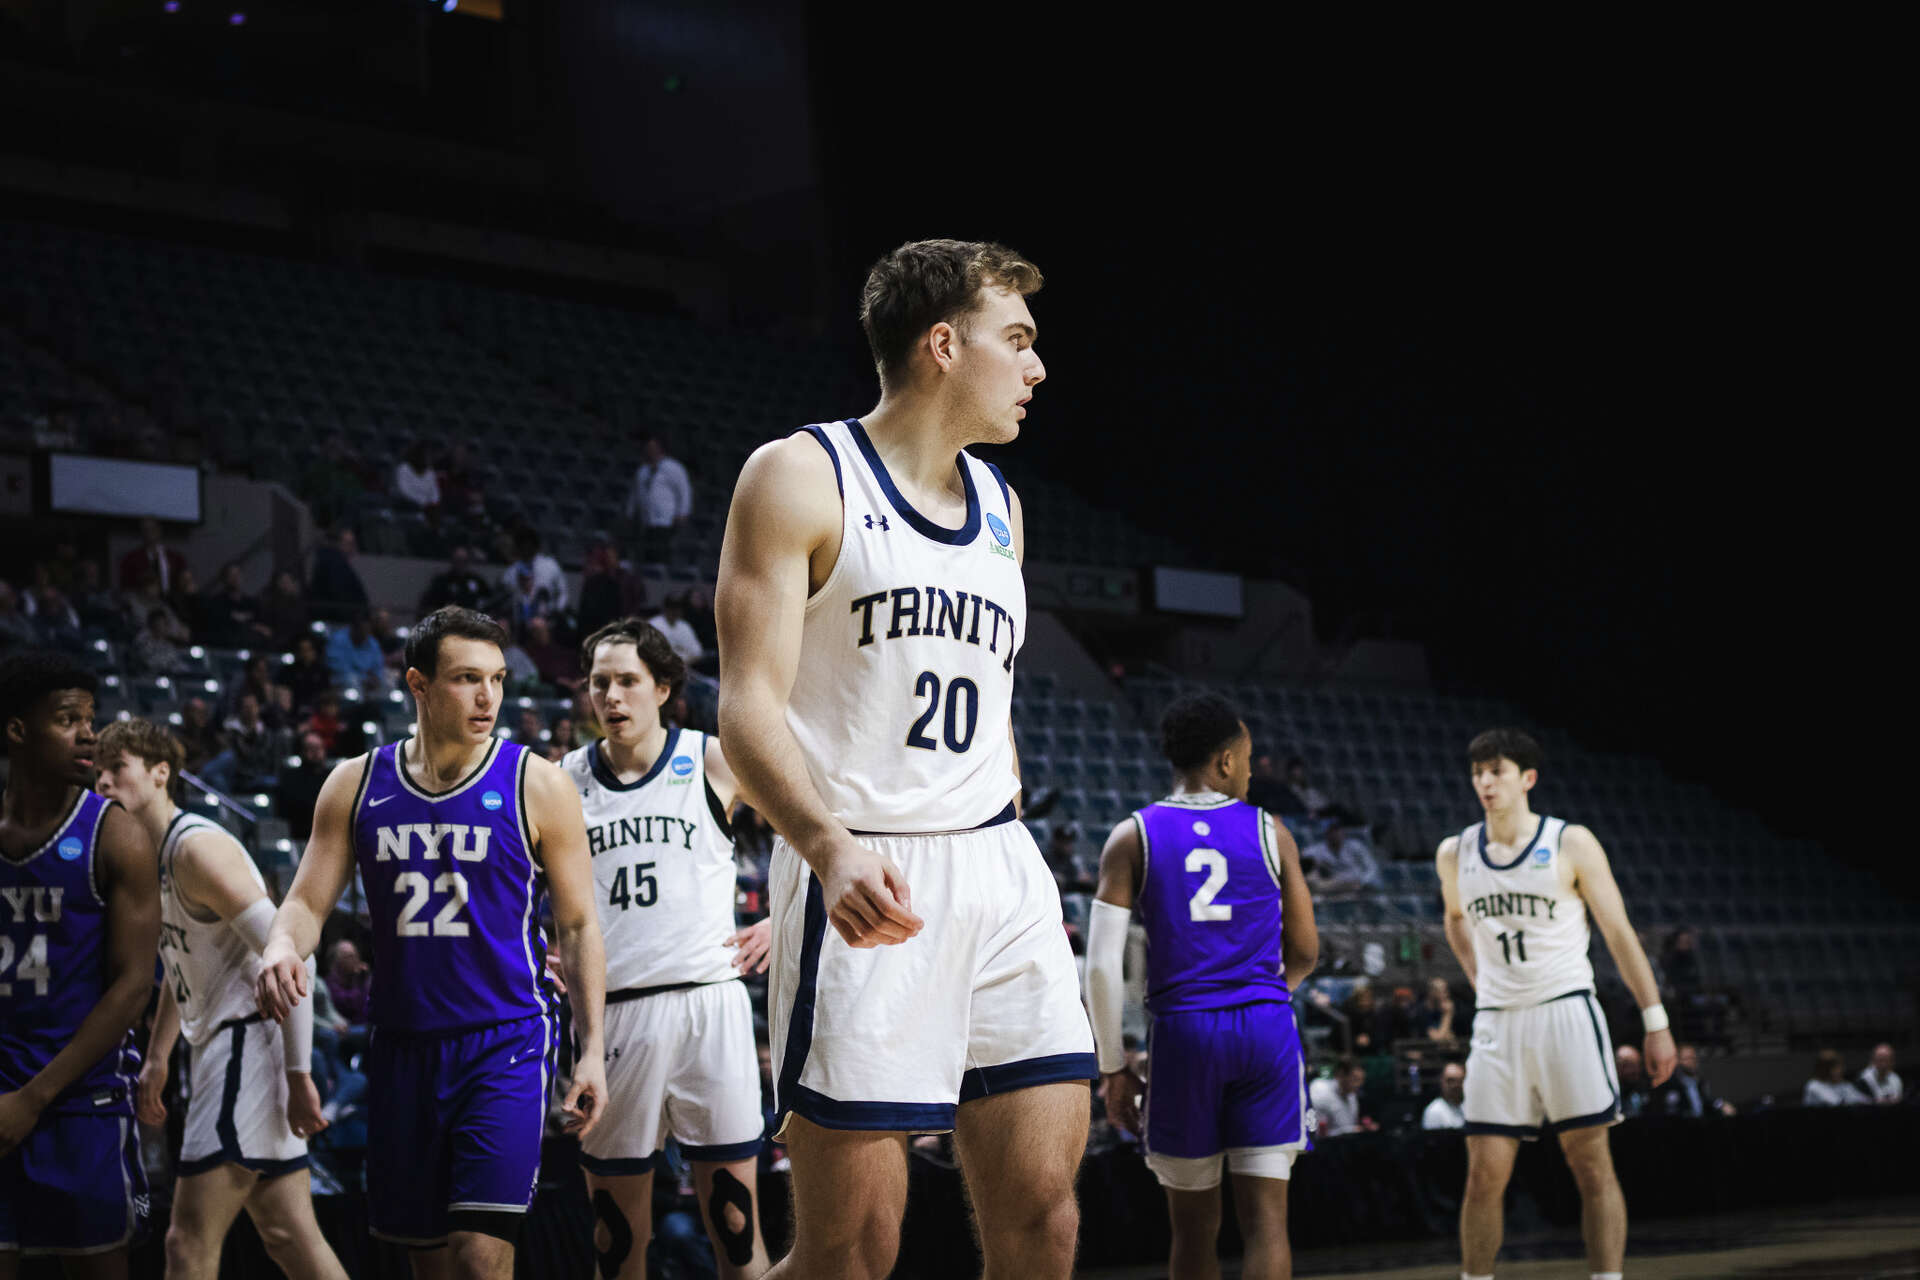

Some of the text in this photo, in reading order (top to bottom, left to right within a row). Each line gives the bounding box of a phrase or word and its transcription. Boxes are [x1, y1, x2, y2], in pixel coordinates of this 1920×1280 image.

[850, 586, 1016, 675] TRINITY
[904, 669, 981, 755] 20
[375, 823, 493, 862] NYU
[586, 815, 697, 858] RINITY
[0, 886, 65, 923] YU
[393, 871, 471, 937] 22
[609, 860, 659, 912] 45
[1184, 847, 1233, 922] 2
[1495, 929, 1528, 966] 11
